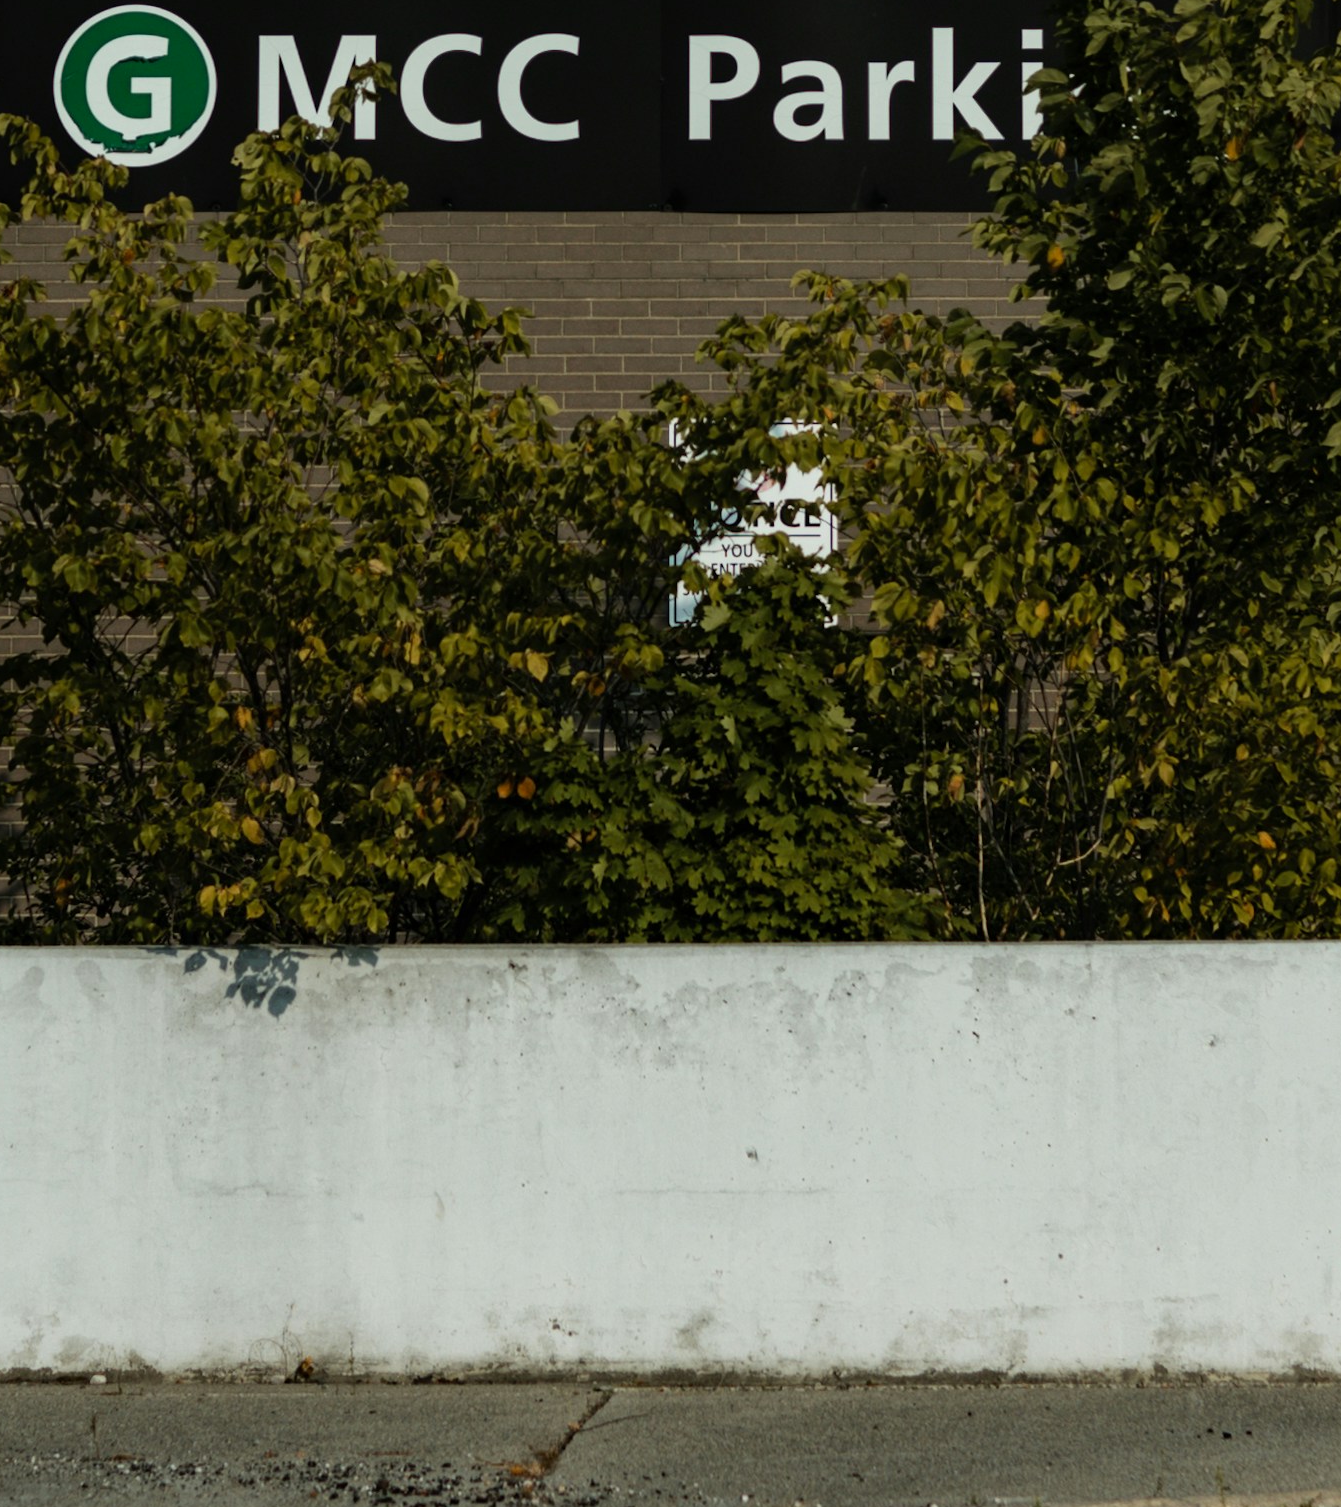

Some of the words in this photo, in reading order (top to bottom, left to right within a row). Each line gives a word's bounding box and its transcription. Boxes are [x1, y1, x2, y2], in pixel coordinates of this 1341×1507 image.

[86, 34, 172, 140] G
[257, 33, 580, 141] MCC
[688, 28, 1045, 141] Parki
[722, 544, 753, 558] YOU
